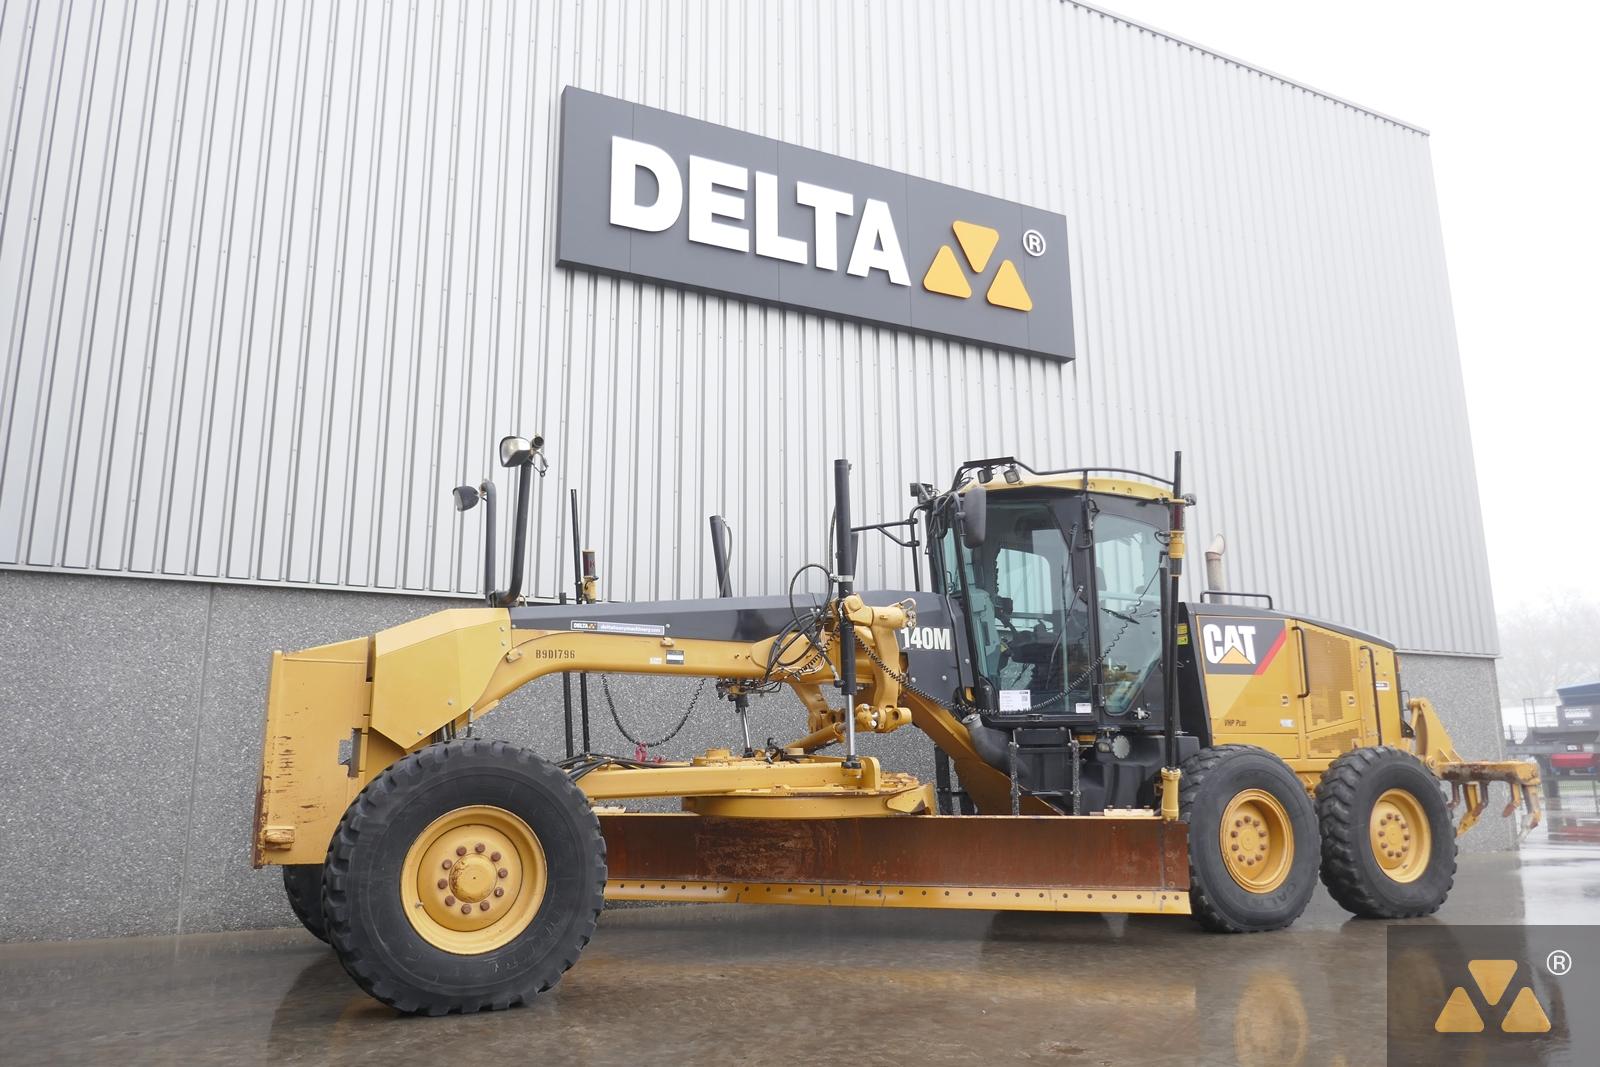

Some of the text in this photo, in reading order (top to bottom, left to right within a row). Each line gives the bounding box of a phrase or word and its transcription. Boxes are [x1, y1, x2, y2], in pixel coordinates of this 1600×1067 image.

[609, 136, 911, 287] DELTA
[535, 649, 575, 659] B9D1796
[900, 627, 951, 650] 140M
[1203, 623, 1256, 665] CAT
